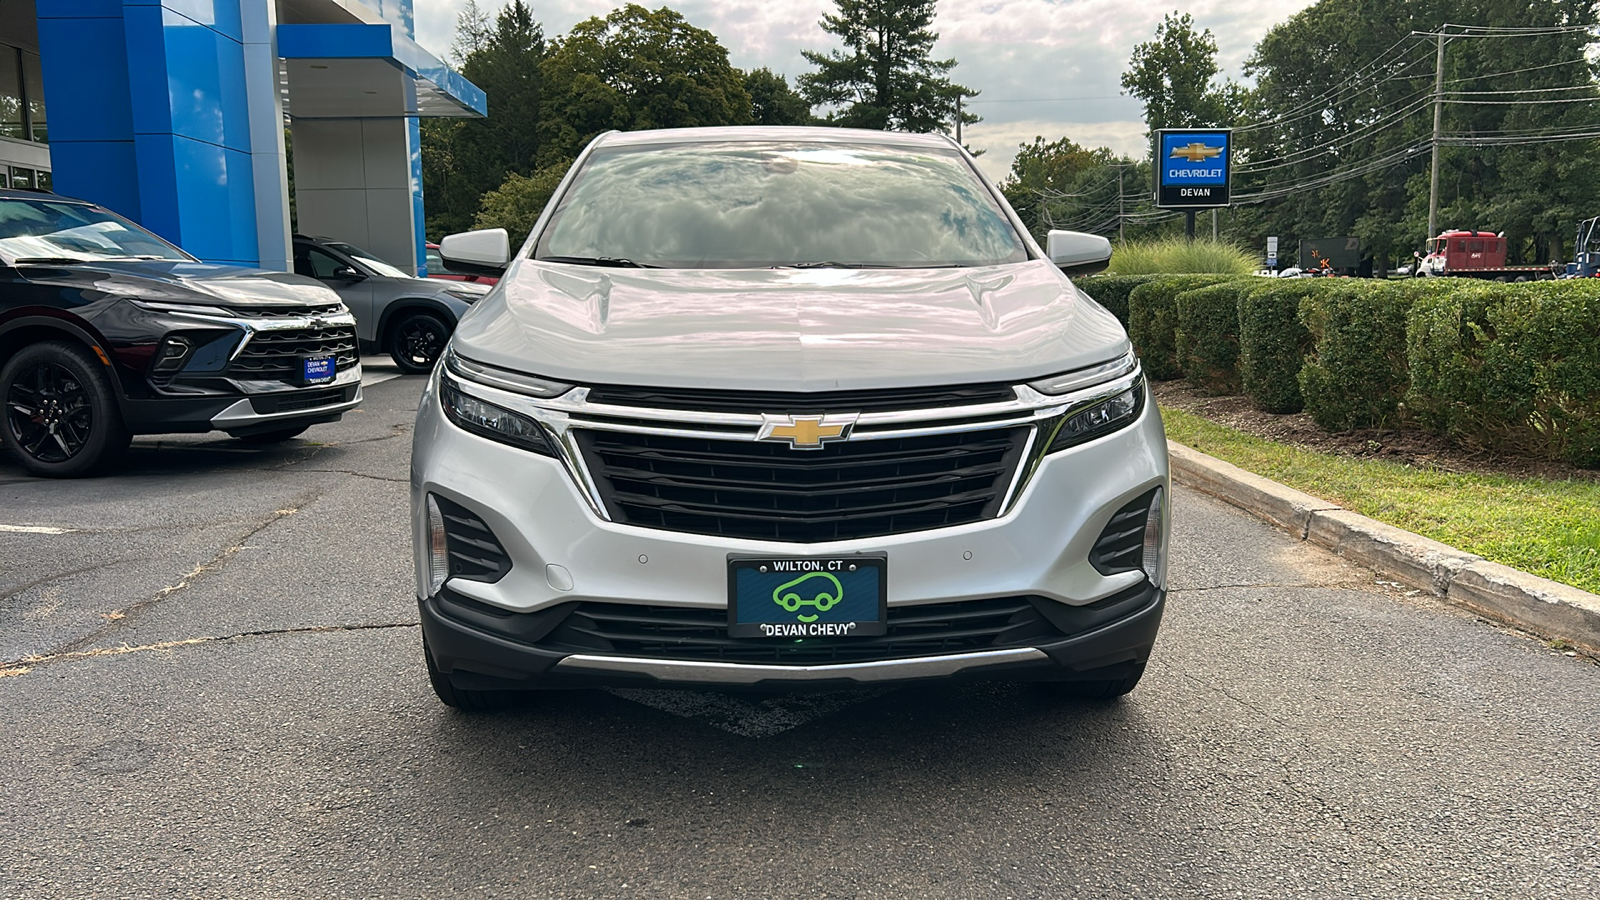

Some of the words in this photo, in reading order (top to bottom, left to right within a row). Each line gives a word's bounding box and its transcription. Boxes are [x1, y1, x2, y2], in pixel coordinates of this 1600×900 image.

[1169, 169, 1222, 178] CHEVROLET
[1180, 188, 1211, 197] DEVAN
[773, 560, 824, 571] WILTON,
[827, 560, 843, 571] CT
[766, 624, 807, 636] DEVAN
[809, 623, 849, 635] CHEVY
